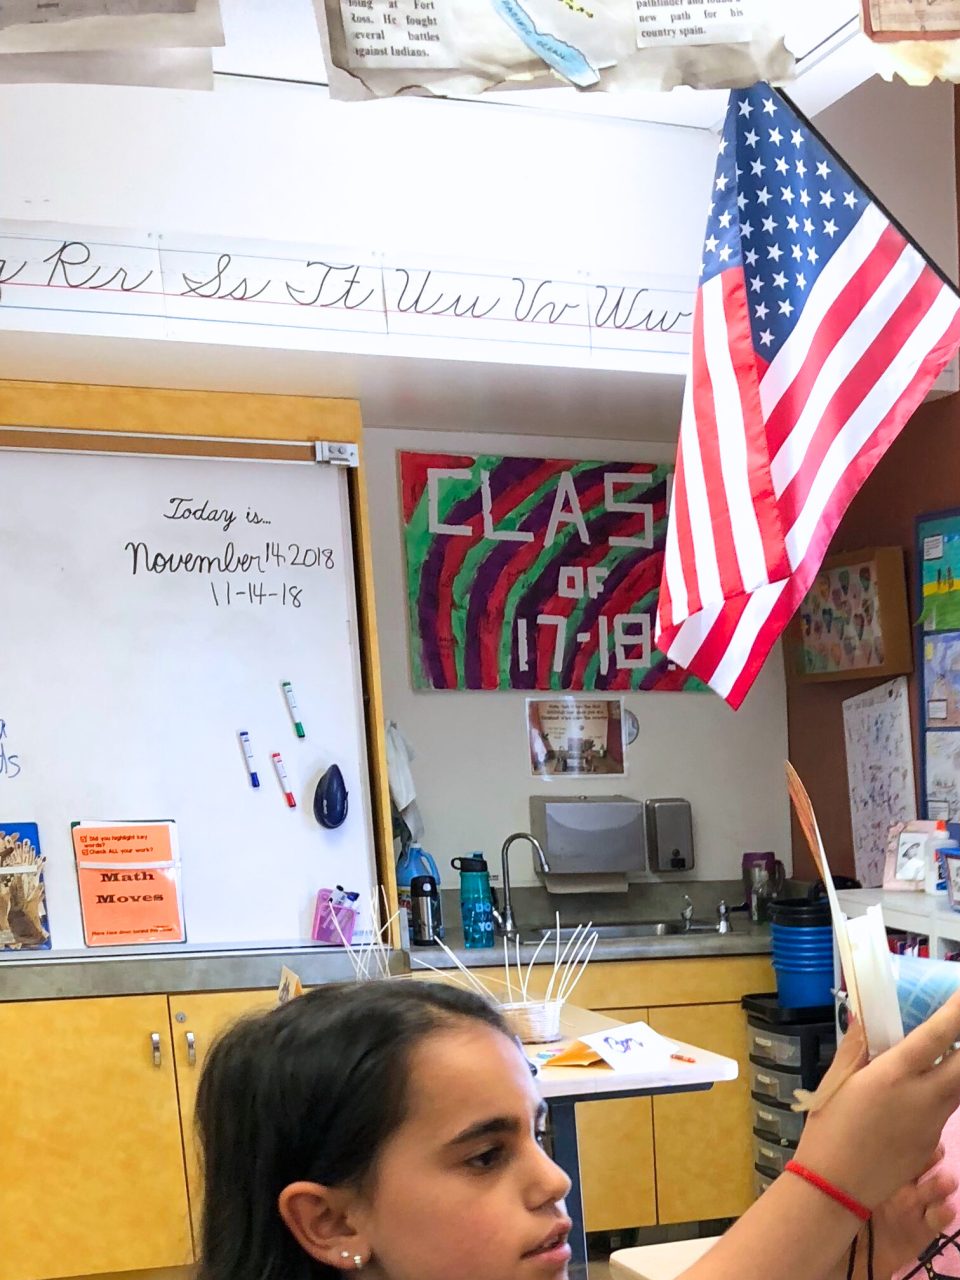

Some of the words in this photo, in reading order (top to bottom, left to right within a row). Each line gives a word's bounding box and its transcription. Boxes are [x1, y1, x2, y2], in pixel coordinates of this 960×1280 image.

[406, 15, 438, 27] fought
[670, 11, 691, 23] path
[703, 9, 717, 19] for
[730, 8, 744, 17] his
[354, 29, 385, 40] everal
[407, 31, 440, 41] battles
[641, 27, 677, 38] country
[163, 497, 236, 531] Today
[427, 468, 674, 549] CLAS
[125, 542, 266, 575] November
[288, 543, 335, 569] 2018
[558, 566, 609, 599] OF
[211, 580, 303, 608] 11-14-18
[100, 871, 155, 883] Math
[95, 893, 164, 904] Moves
[478, 921, 494, 931] YO
